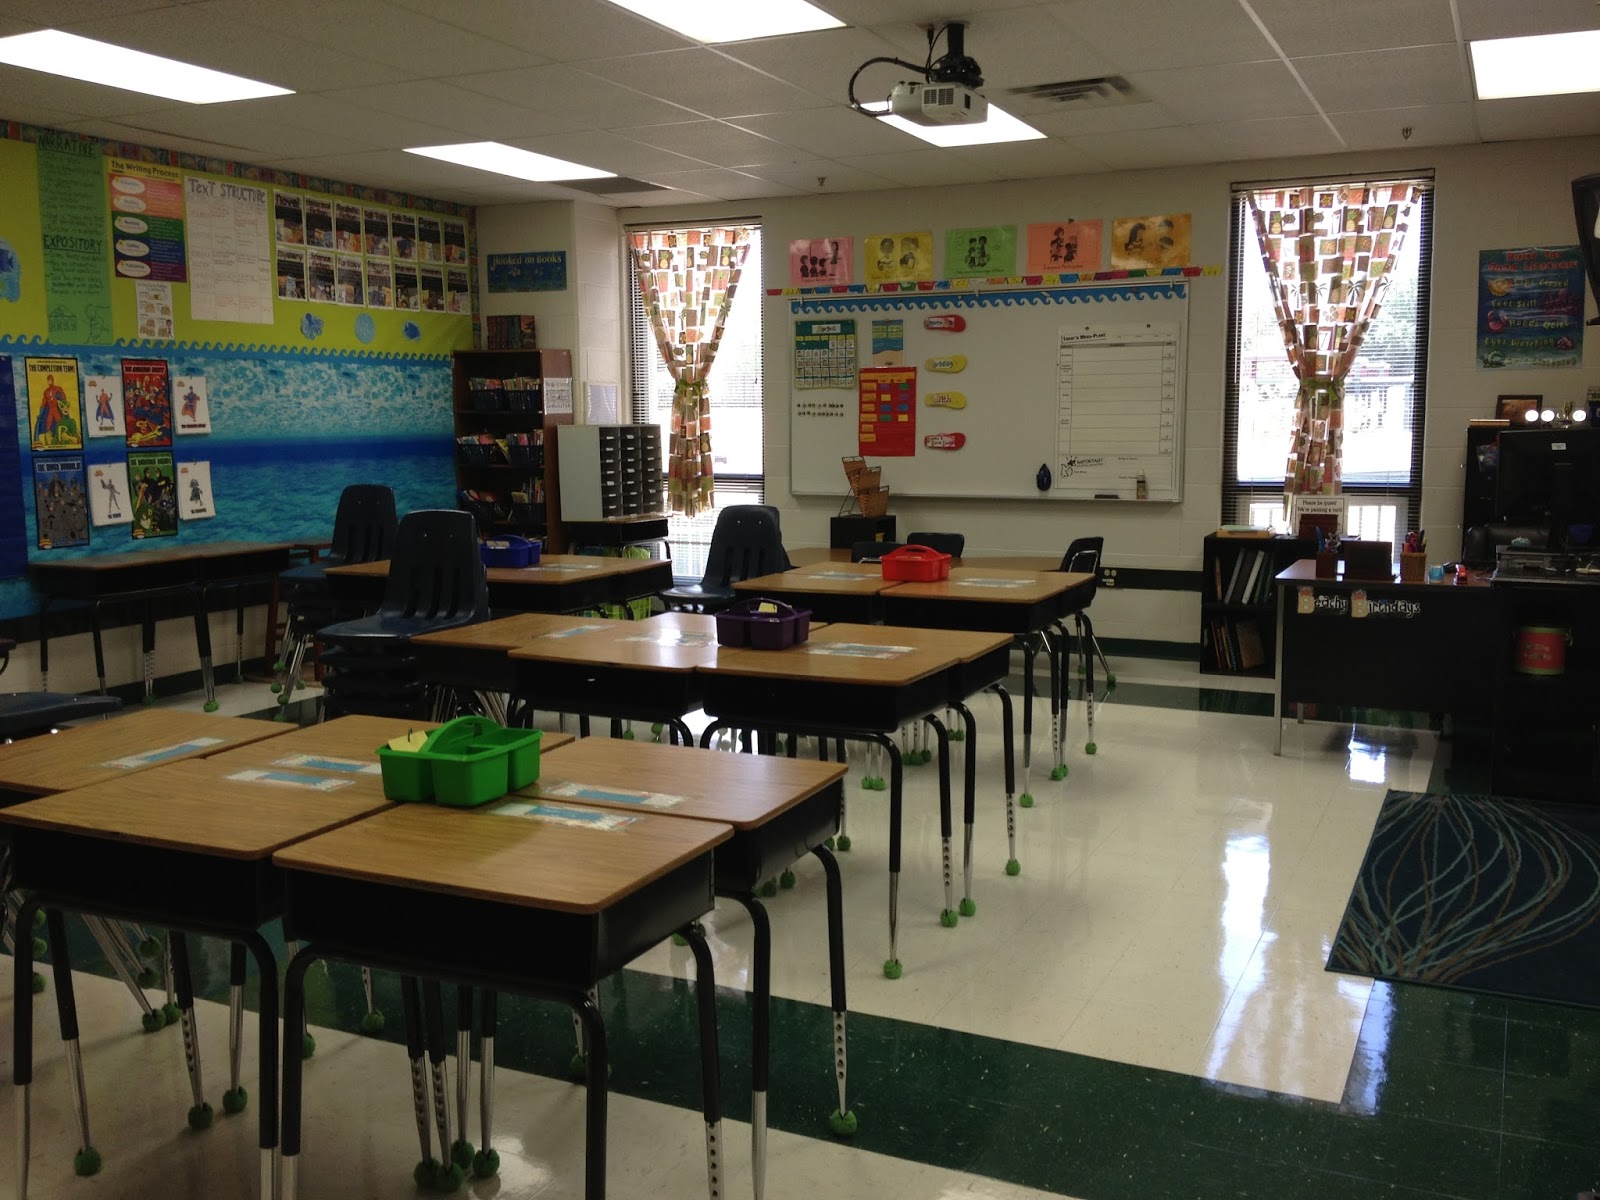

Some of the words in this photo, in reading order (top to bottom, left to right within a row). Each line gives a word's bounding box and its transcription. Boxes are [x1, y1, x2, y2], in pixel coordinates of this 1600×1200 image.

[38, 134, 96, 156] NARRATIVE
[112, 160, 124, 170] The
[125, 163, 151, 174] Writing
[152, 168, 178, 178] Process
[43, 234, 102, 253] EXPOSITORY
[492, 255, 522, 269] Hooked
[524, 255, 535, 264] on
[536, 253, 562, 264] Books
[28, 364, 37, 372] THE
[1297, 590, 1348, 615] Beachy
[1351, 592, 1421, 619] Birthdays
